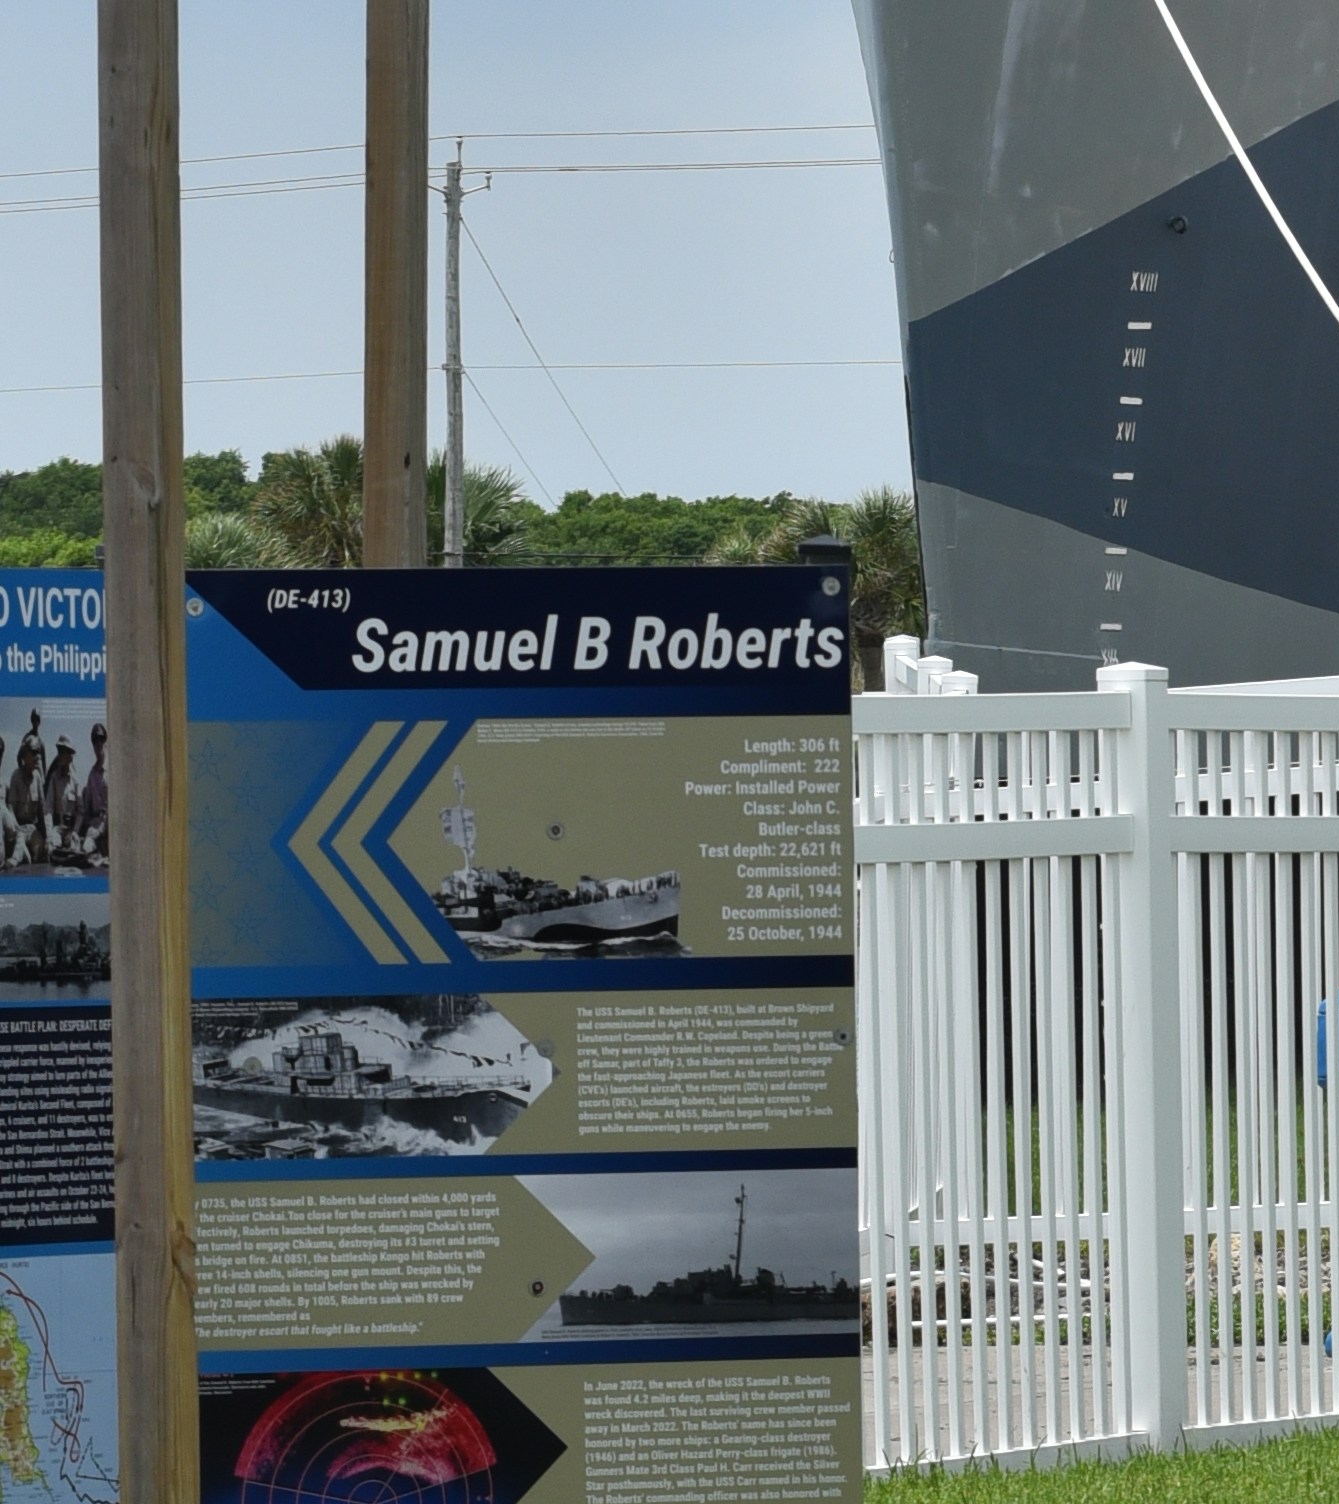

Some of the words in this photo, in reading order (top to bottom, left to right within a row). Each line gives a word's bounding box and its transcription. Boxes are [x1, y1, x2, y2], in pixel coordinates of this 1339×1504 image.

[1131, 272, 1158, 291] XVIII
[1123, 348, 1145, 367] XVII
[1116, 422, 1135, 441] XVI
[1113, 498, 1127, 516] XV
[1105, 572, 1122, 591] XIV
[17, 586, 106, 629] VICTO
[268, 589, 350, 612] (DE-413)
[352, 614, 558, 672] Samuel
[574, 617, 610, 669] B
[629, 613, 844, 669] Roberts
[7, 642, 35, 672] the
[745, 738, 795, 756] Length:
[800, 739, 825, 752] 306
[829, 738, 839, 751] ft
[721, 760, 806, 777] Compliment:
[815, 759, 839, 772] 222
[685, 782, 731, 795] Power:
[736, 780, 794, 794] Installed
[798, 780, 840, 793] Power
[744, 801, 784, 815] Class:
[789, 800, 822, 814] John
[826, 800, 839, 814] C.
[759, 821, 840, 836] Butler-class
[699, 844, 729, 857] Test
[733, 843, 775, 860] depth:
[780, 842, 824, 858] 22,621
[831, 841, 841, 855] ft
[737, 862, 841, 878] Commissioned:
[747, 885, 762, 898] 28
[767, 884, 803, 901] April,
[809, 884, 841, 897] 1944
[722, 904, 841, 919] Decommissioned:
[728, 927, 744, 940] 25
[749, 926, 804, 941] October,
[809, 925, 842, 938] 1944
[201, 1198, 228, 1209] 0735,
[230, 1198, 245, 1208] the
[248, 1197, 267, 1207] USS
[270, 1196, 305, 1207] Samuel
[307, 1196, 317, 1206] B.
[320, 1195, 356, 1205] Roberts
[358, 1194, 376, 1205] had
[378, 1193, 409, 1204] closed
[411, 1193, 440, 1203] within
[442, 1193, 468, 1204] 4,000
[470, 1192, 496, 1205] yards
[242, 1226, 279, 1236] Roberts
[282, 1224, 324, 1235] launched
[326, 1224, 376, 1236] torpedoes,
[378, 1223, 424, 1235] damaging
[467, 1222, 494, 1232] stern,
[216, 1269, 251, 1279] 14-inch
[254, 1268, 284, 1279] shells,
[287, 1267, 329, 1279] silencing
[332, 1269, 349, 1277] one
[351, 1268, 369, 1279] gun
[371, 1266, 404, 1276] mount.
[406, 1265, 442, 1277] Despite
[444, 1264, 465, 1275] this,
[467, 1263, 482, 1273] the
[213, 1327, 257, 1339] destroyer
[259, 1326, 289, 1336] escort
[291, 1325, 309, 1335] that
[311, 1324, 342, 1336] fought
[344, 1323, 361, 1334] like
